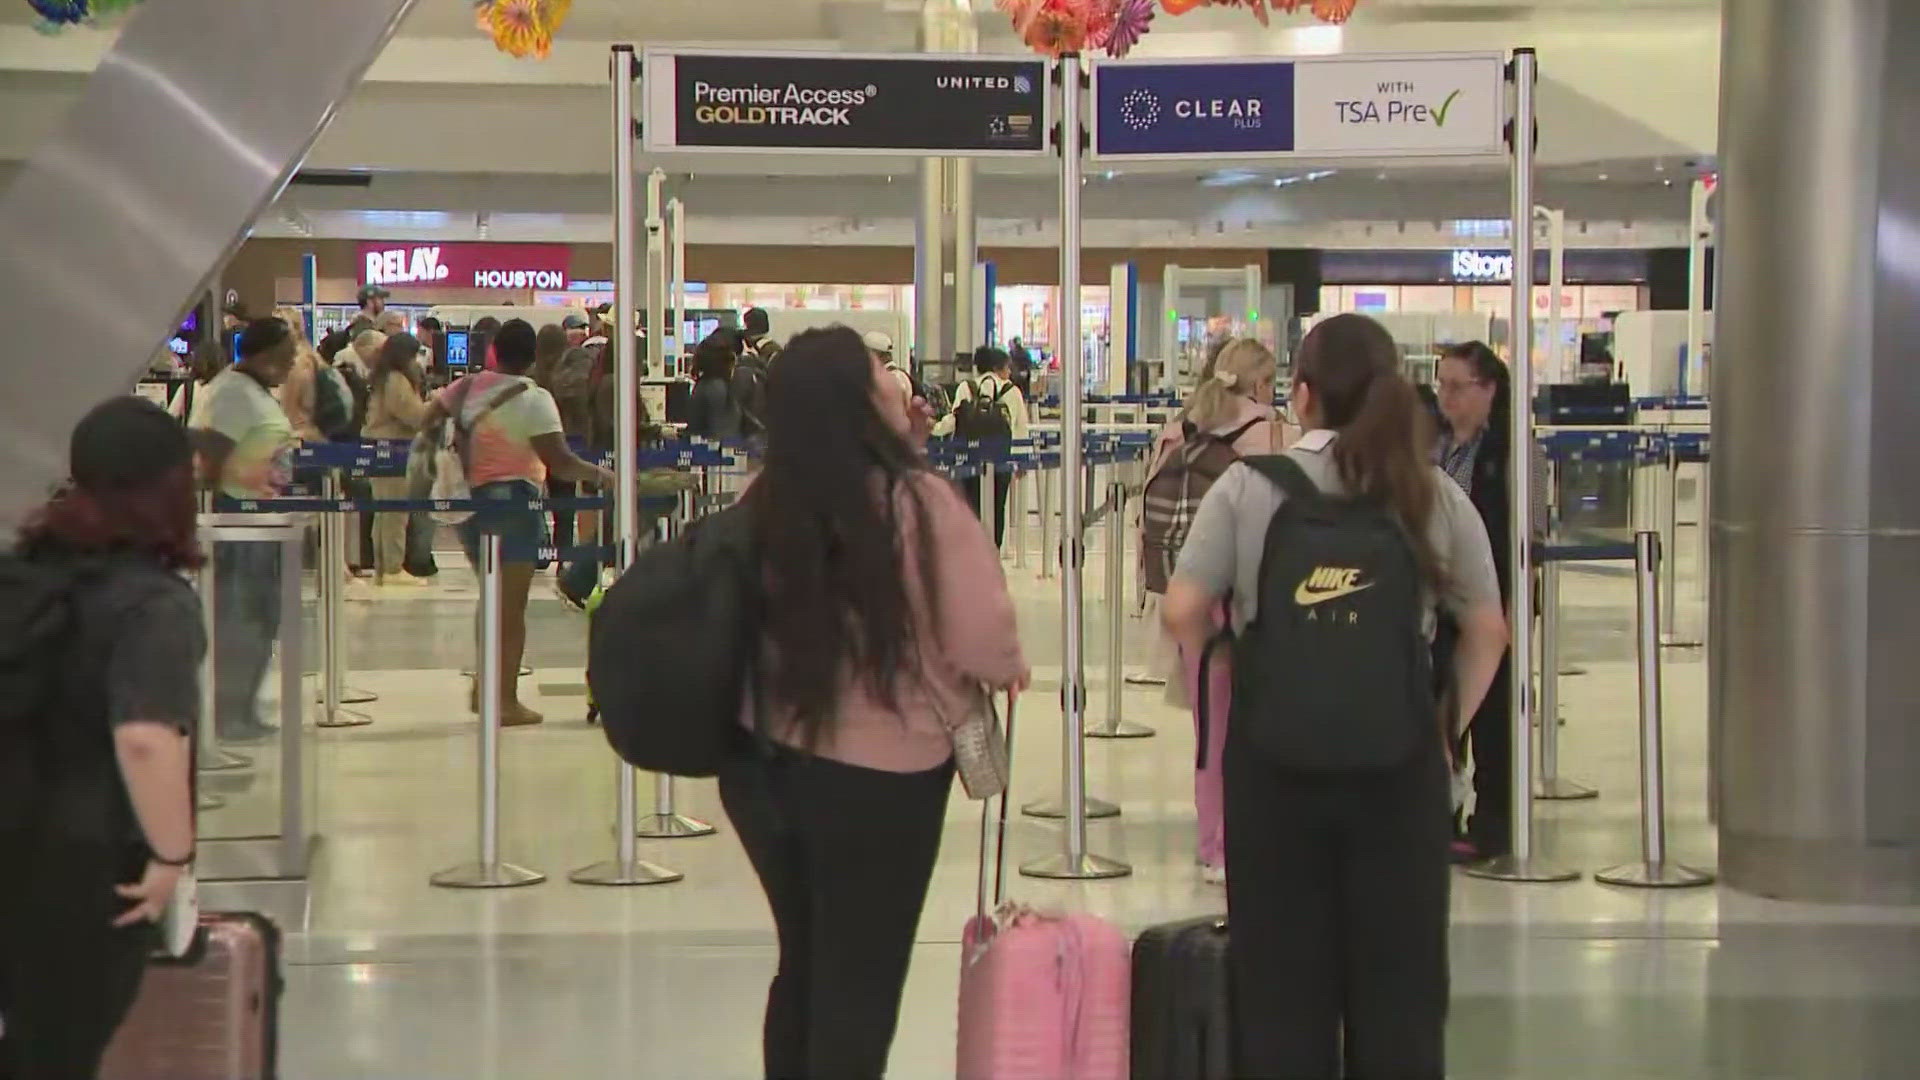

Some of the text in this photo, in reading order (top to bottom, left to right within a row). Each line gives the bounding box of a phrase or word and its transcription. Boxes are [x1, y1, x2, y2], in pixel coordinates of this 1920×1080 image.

[937, 76, 1010, 90] UNITED
[1376, 81, 1414, 94] WITH
[694, 81, 781, 105] Premier
[695, 106, 850, 126] GOLDTRACK
[1175, 98, 1262, 119] CLEAR
[1335, 100, 1380, 124] TSA
[1233, 119, 1262, 130] PLUS
[475, 271, 563, 290] HOUSTON
[528, 500, 543, 510] IAH
[537, 547, 558, 560] IAH
[1308, 567, 1361, 589] NIKE
[1308, 609, 1358, 624] AIR
